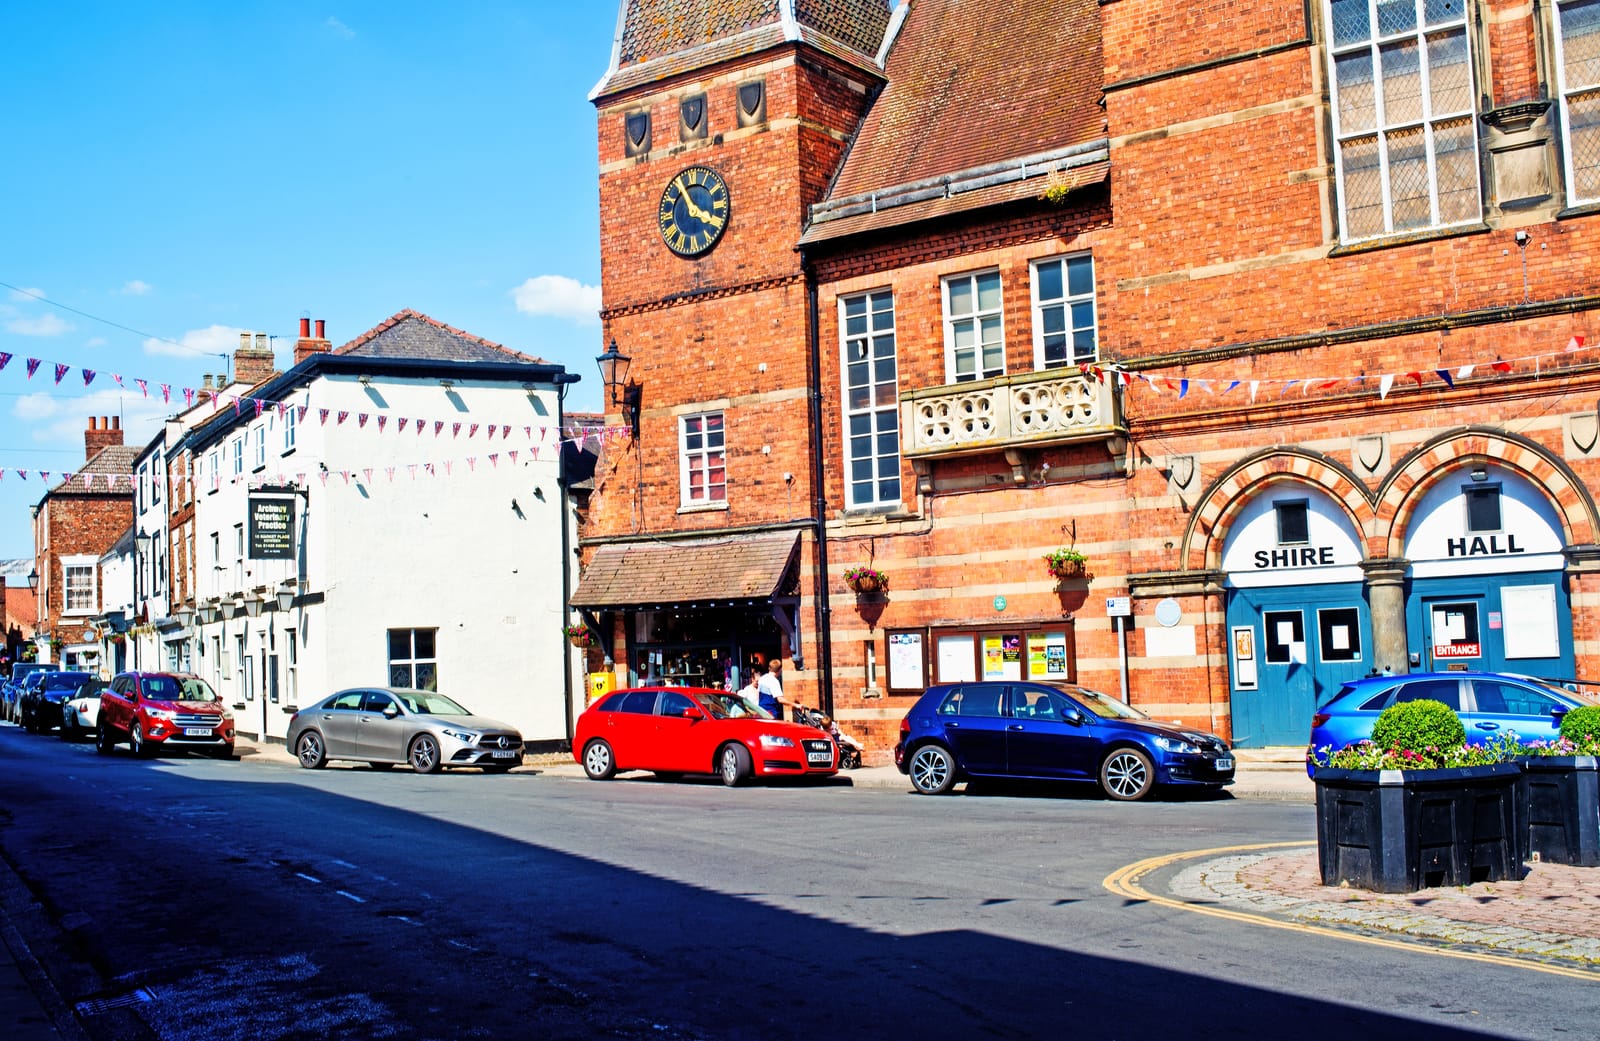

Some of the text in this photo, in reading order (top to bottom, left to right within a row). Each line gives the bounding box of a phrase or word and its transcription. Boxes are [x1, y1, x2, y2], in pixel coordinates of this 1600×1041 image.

[254, 513, 290, 522] Veterinary
[258, 521, 287, 530] Practice
[1447, 534, 1524, 557] HALL
[1254, 546, 1335, 569] SHIRE
[1436, 645, 1478, 656] ENTRANCE
